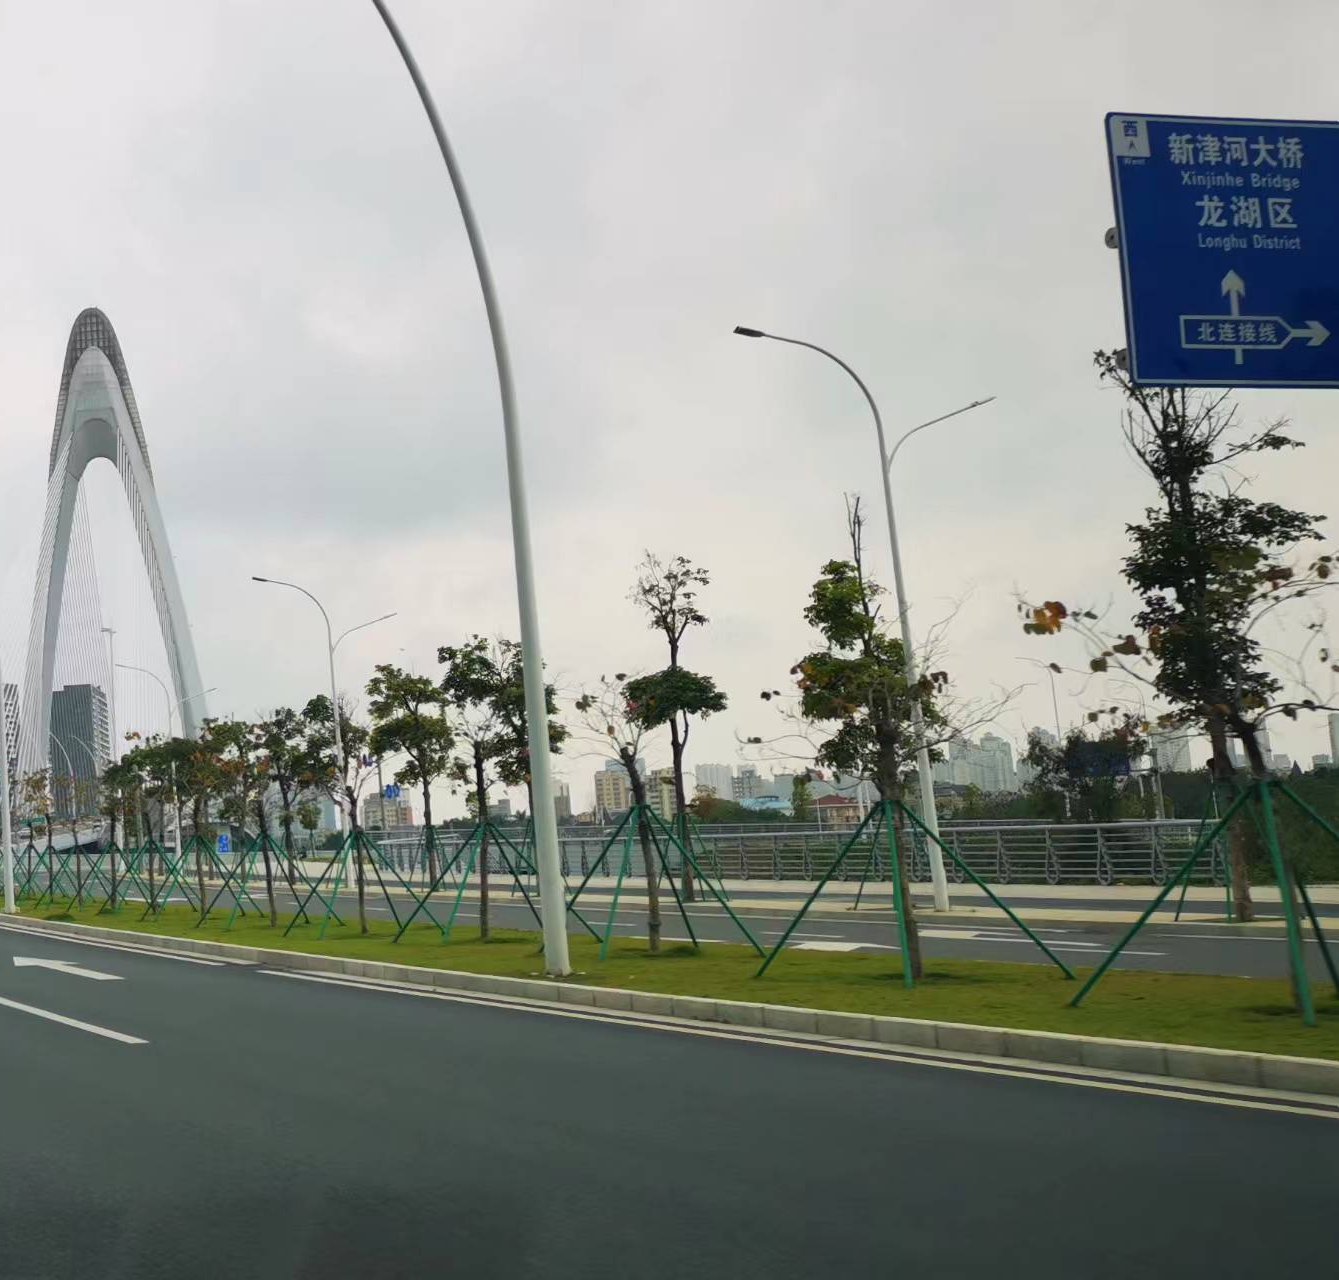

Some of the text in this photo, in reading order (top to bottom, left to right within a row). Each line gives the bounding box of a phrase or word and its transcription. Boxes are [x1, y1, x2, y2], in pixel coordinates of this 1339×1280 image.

[1167, 133, 1304, 168] 新津河大桥
[1181, 171, 1301, 191] Xinjinhe Bridge
[1195, 194, 1298, 229] 龙湖区
[1198, 233, 1302, 252] Longhu District
[1197, 322, 1278, 343] 北连接线
